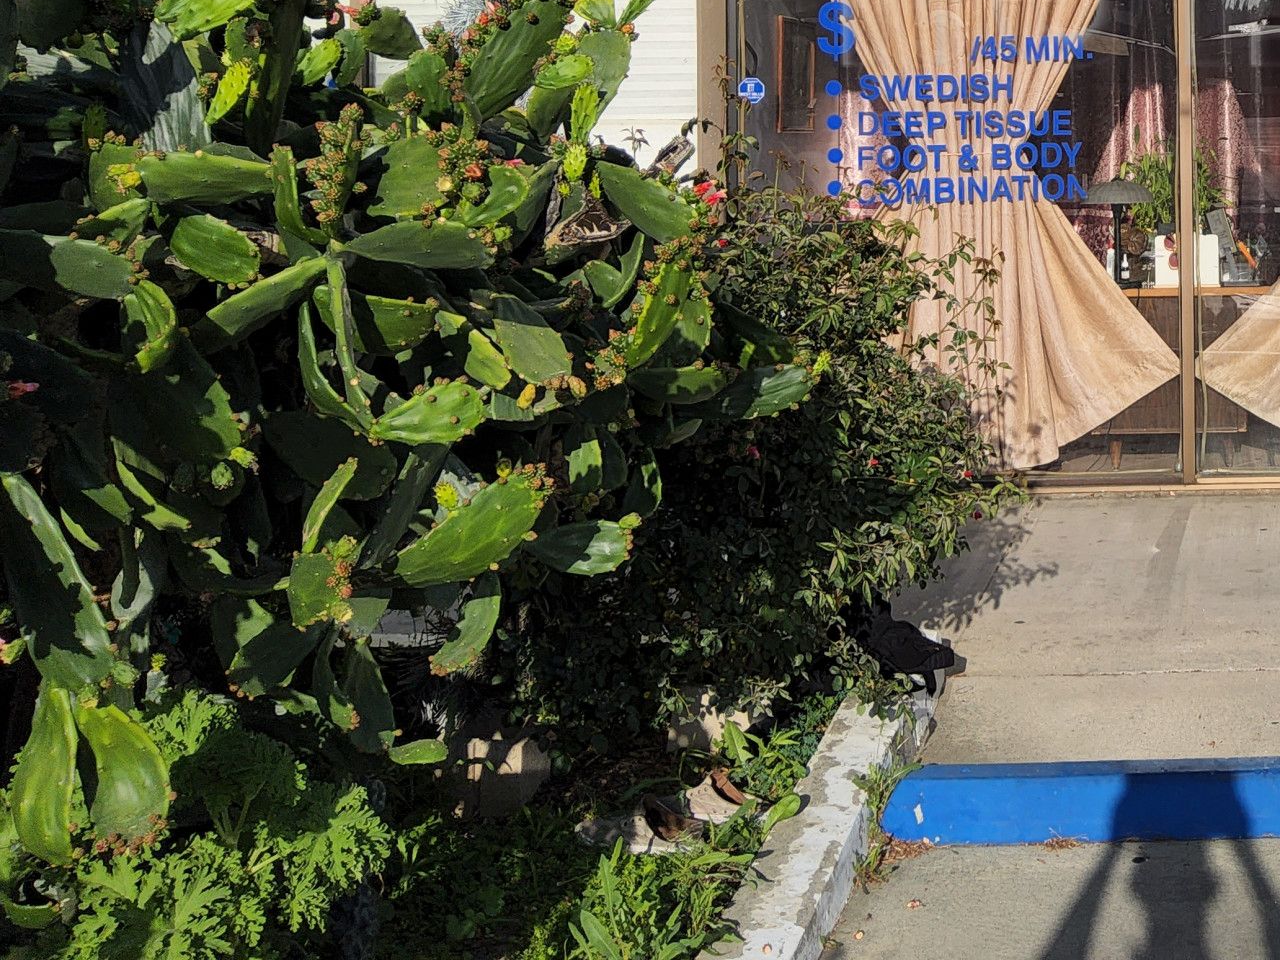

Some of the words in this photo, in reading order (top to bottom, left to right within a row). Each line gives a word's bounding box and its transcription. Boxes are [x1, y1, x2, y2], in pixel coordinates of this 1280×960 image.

[970, 35, 1017, 62] /45
[1025, 34, 1094, 64] MIN.
[858, 74, 1014, 102] SWEDISH
[858, 111, 948, 137] DEEP
[953, 110, 1072, 138] TISSUE
[857, 144, 947, 172] FOOT
[957, 144, 979, 171] &
[991, 141, 1082, 171] BODY
[857, 173, 1088, 205] COMBINATION
